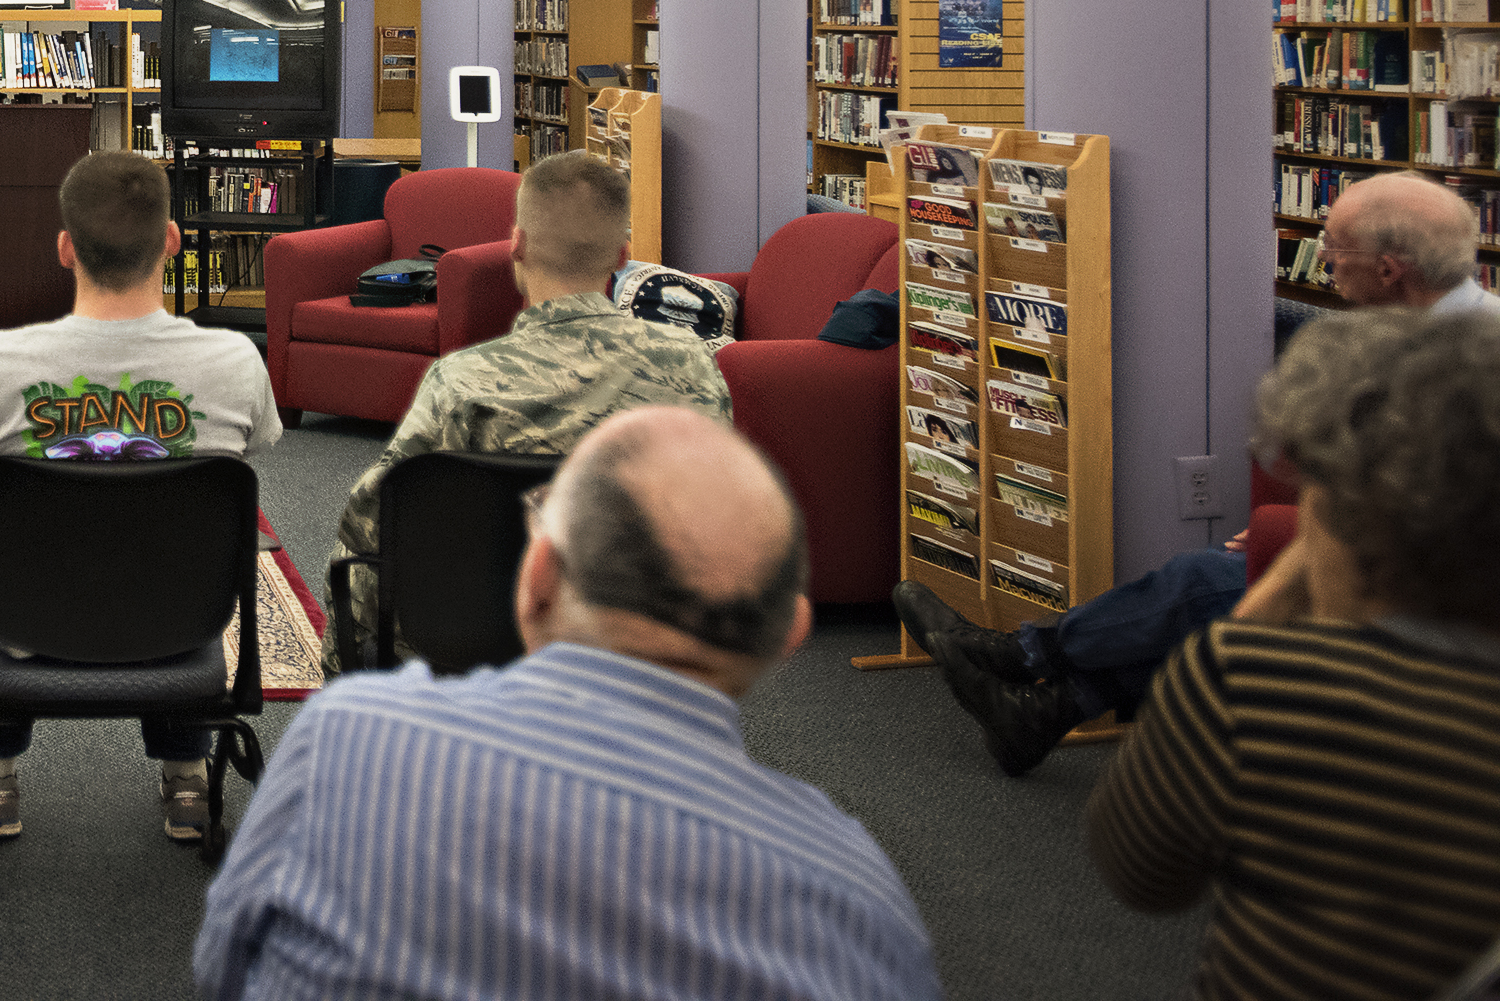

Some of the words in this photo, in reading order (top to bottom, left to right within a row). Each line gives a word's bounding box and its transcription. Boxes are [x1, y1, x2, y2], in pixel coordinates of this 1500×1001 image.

[910, 208, 974, 227] HOUSEKEEPING
[925, 202, 952, 214] GOOD
[993, 295, 1062, 331] MORE
[28, 393, 189, 439] STAND
[995, 398, 1058, 424] FITESS
[997, 577, 1068, 613] Macworld
